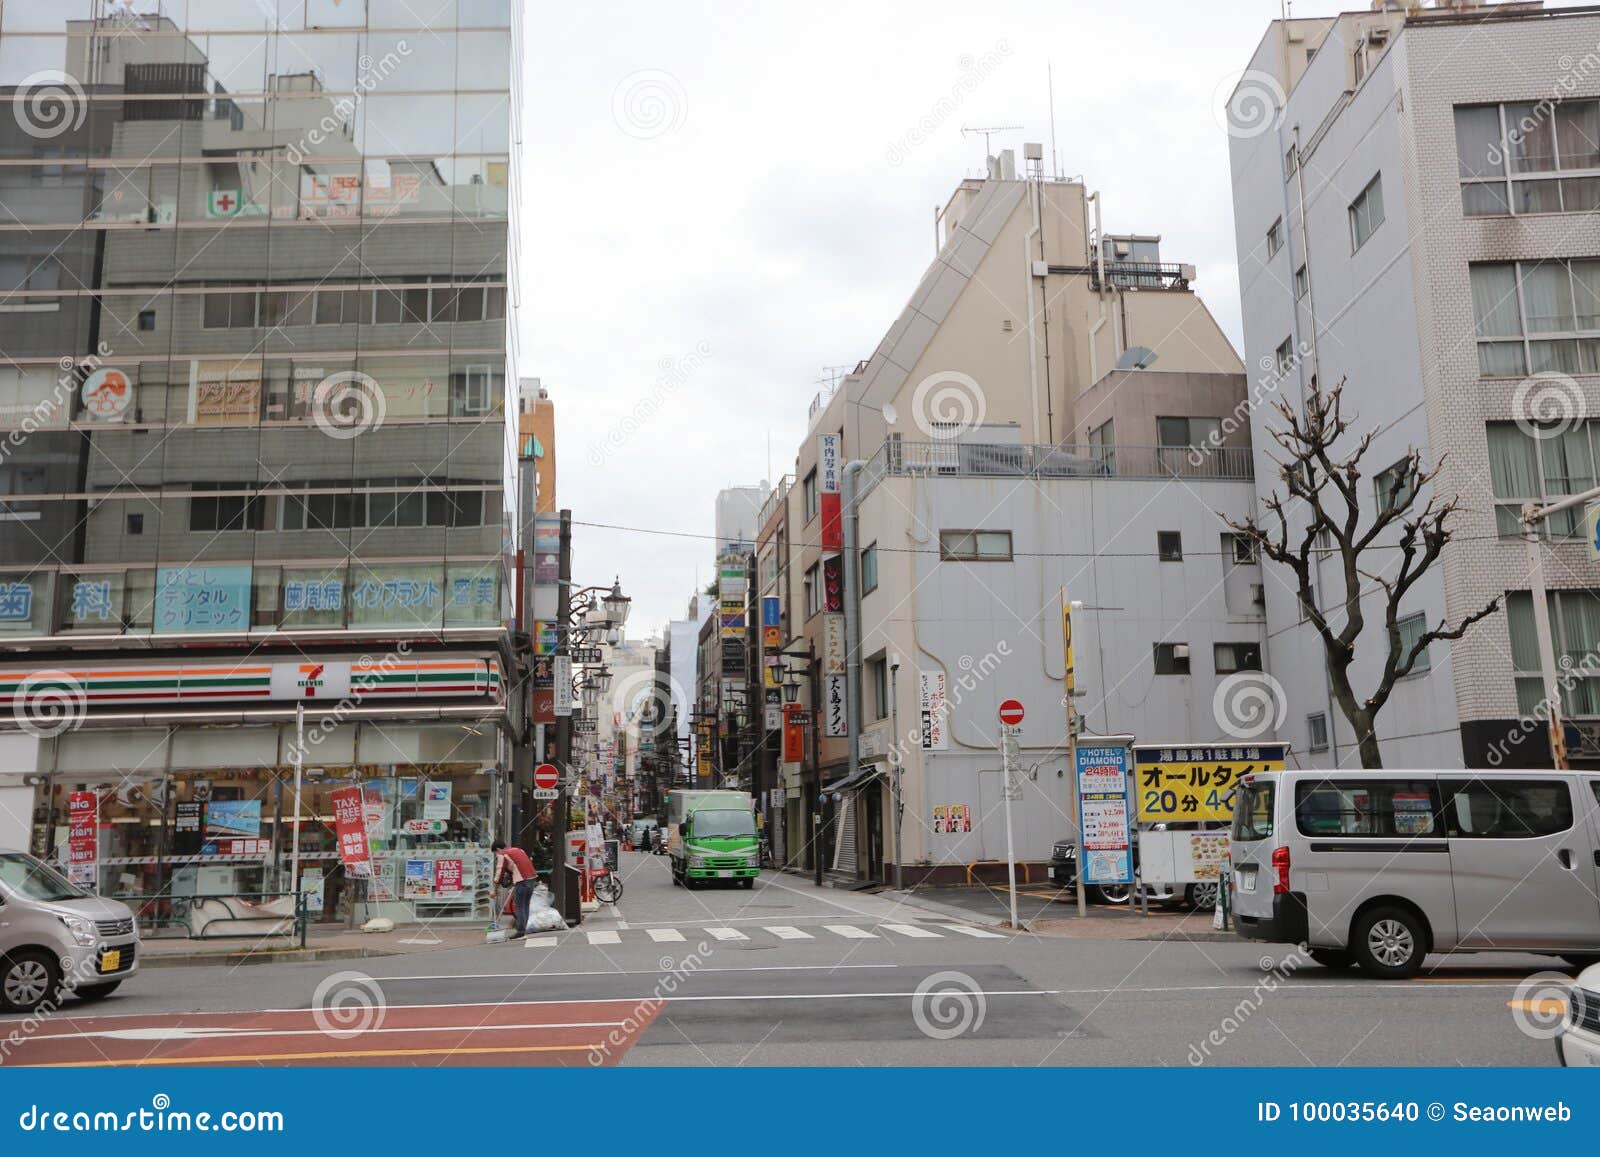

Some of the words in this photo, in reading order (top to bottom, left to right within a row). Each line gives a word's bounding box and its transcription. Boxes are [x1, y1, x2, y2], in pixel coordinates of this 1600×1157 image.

[285, 580, 342, 611] 歯周病
[353, 577, 439, 609] インプラント
[71, 581, 113, 620] 科
[163, 608, 242, 625] クリニック
[1087, 749, 1115, 757] HOTEL
[1080, 757, 1123, 766] DIAMOND
[1085, 765, 1118, 776] 24時間
[1142, 764, 1270, 788] オールタイ
[336, 807, 361, 819] FREE
[409, 821, 429, 831] たばこ
[439, 870, 460, 879] FREE
